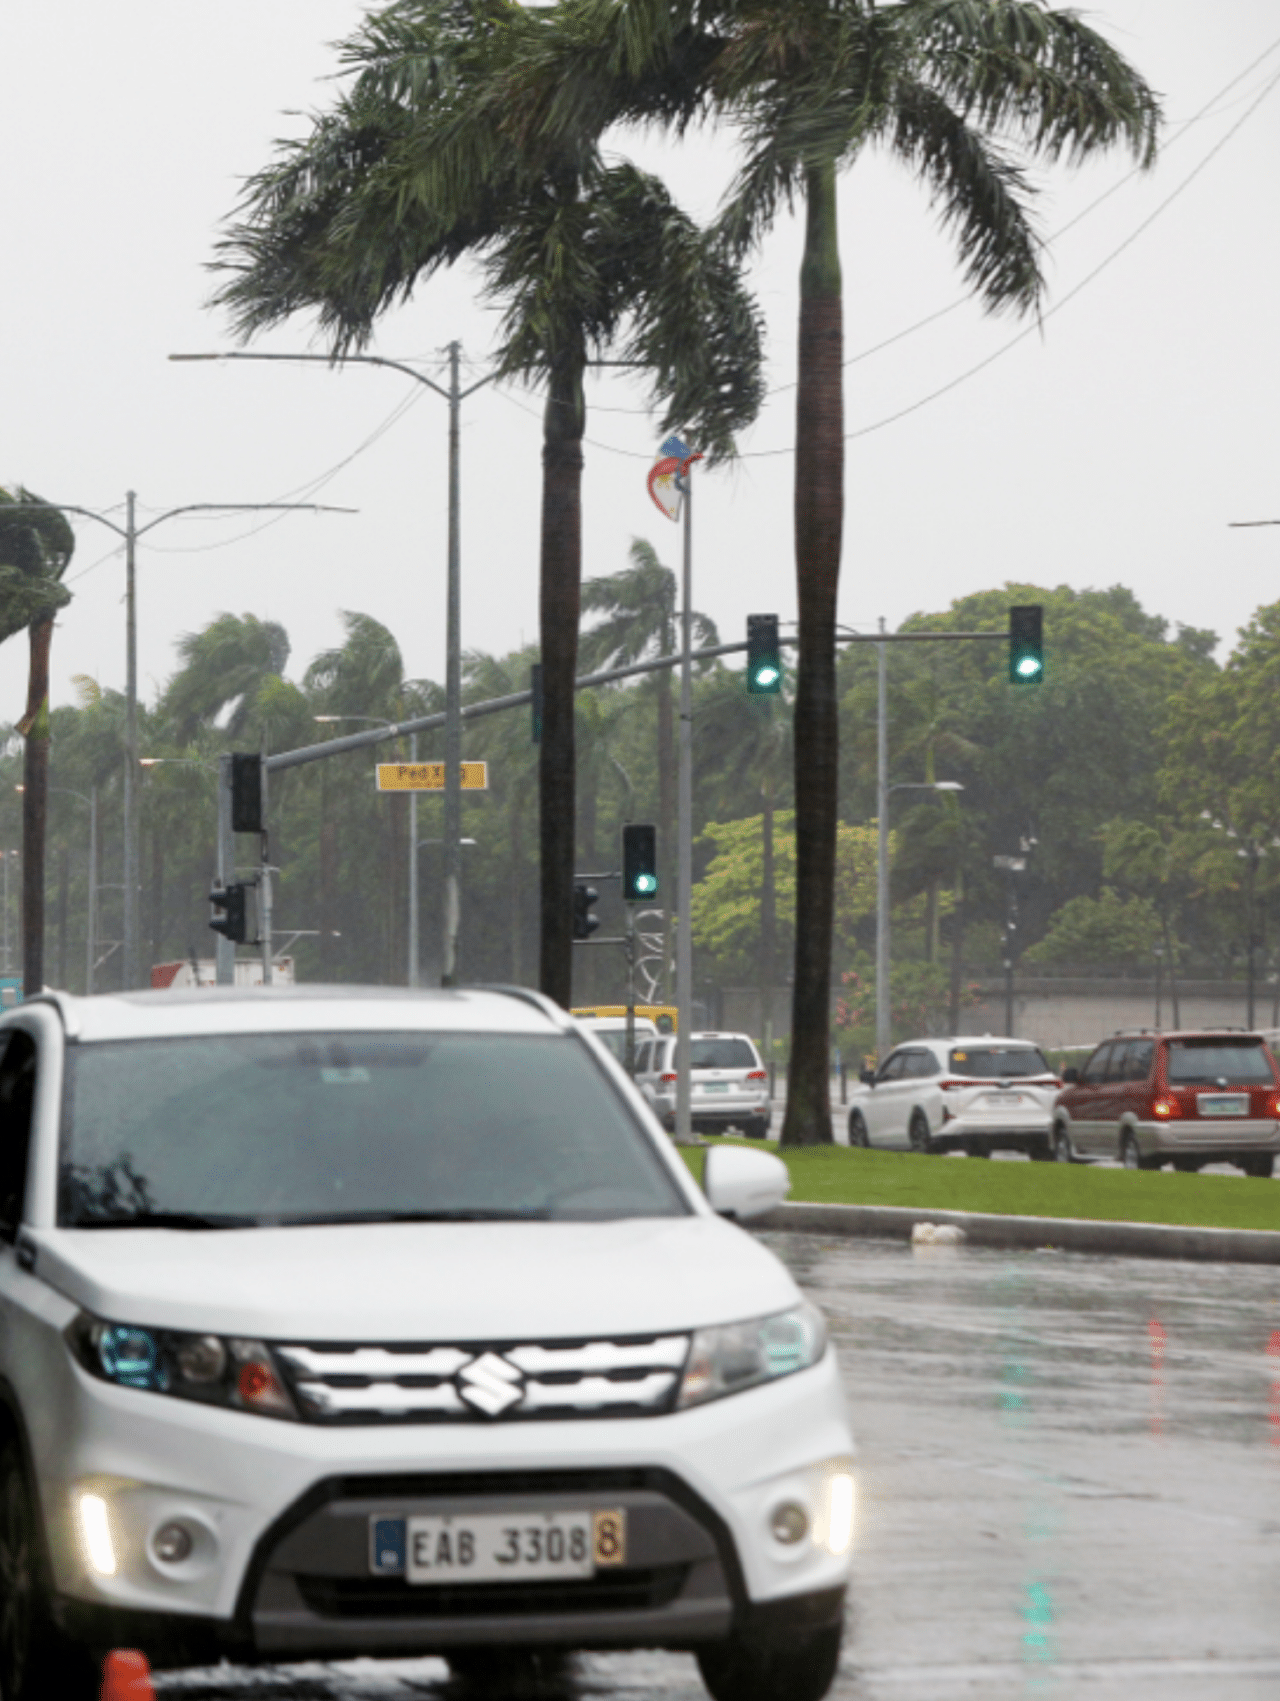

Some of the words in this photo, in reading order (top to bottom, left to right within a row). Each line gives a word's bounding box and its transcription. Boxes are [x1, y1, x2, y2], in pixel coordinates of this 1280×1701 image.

[411, 1530, 476, 1568] EAB
[493, 1526, 588, 1565] 3308
[596, 1518, 619, 1558] 8
